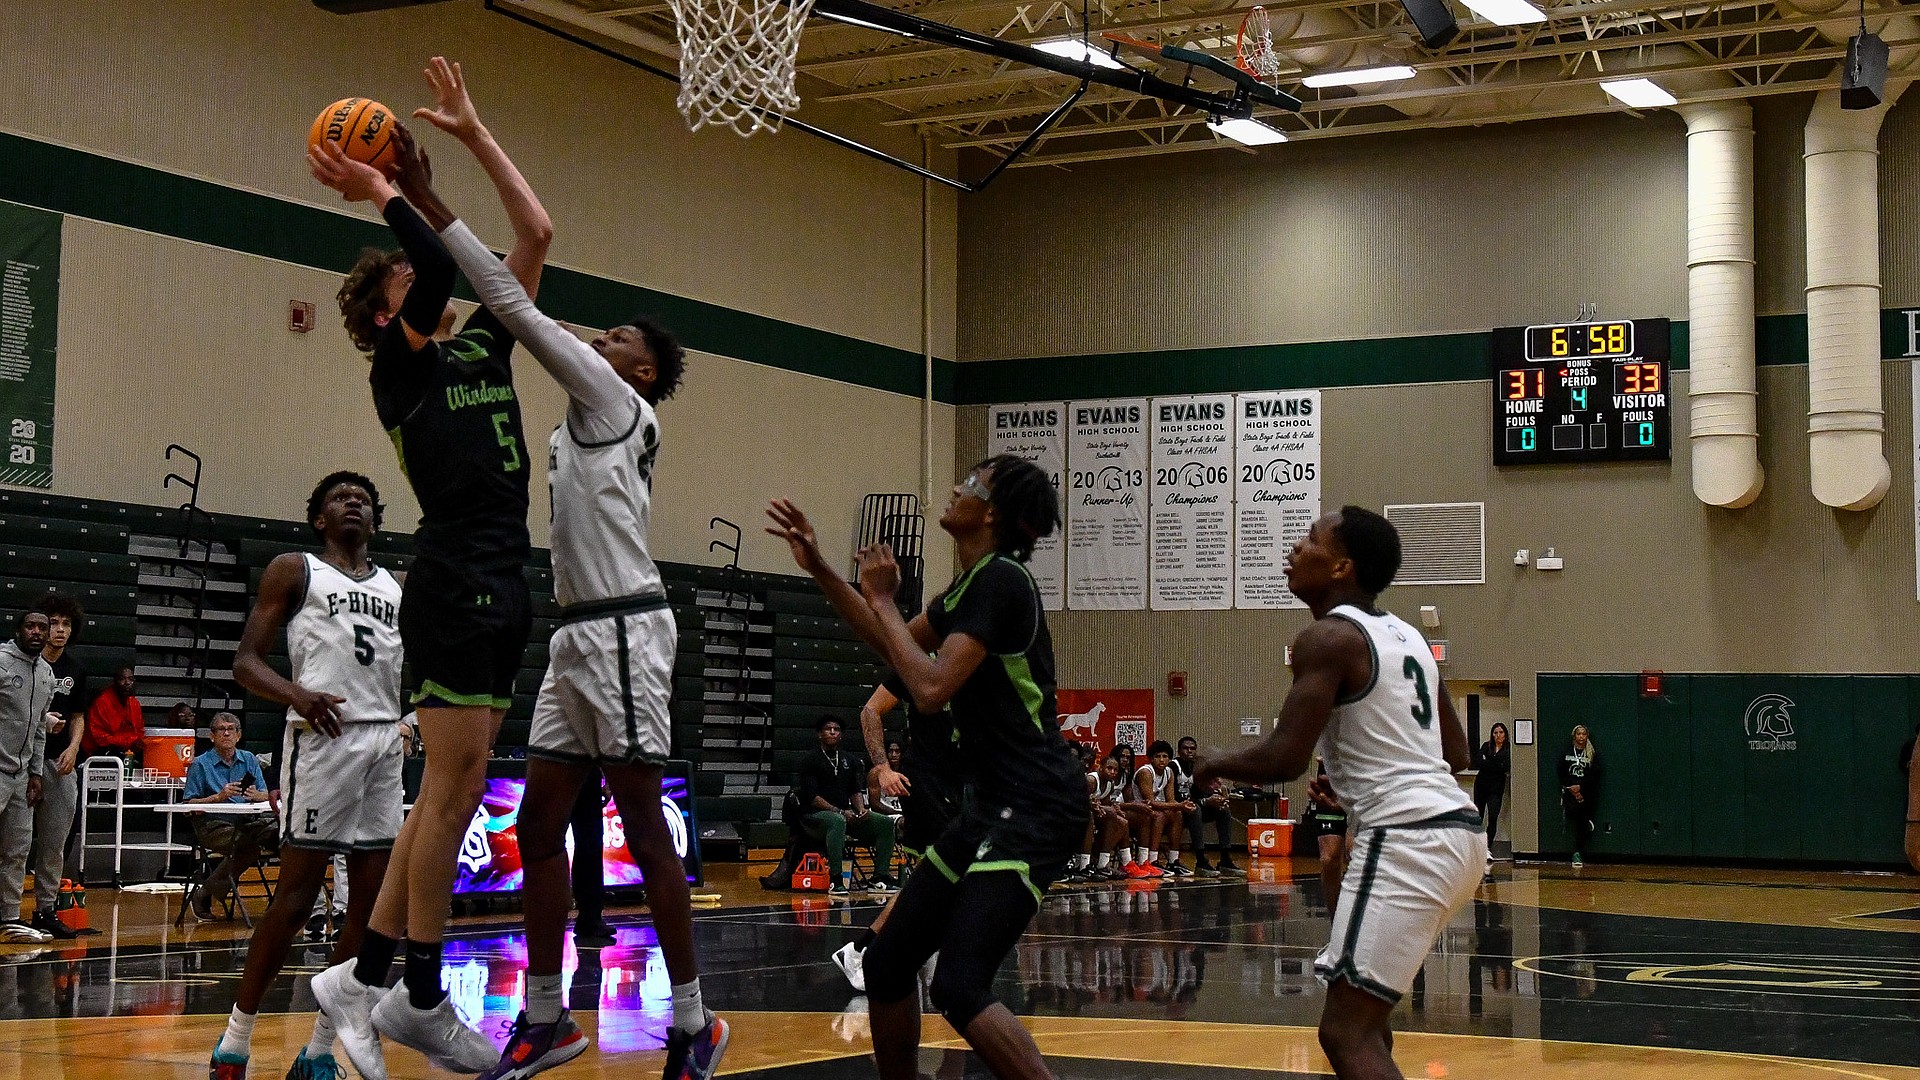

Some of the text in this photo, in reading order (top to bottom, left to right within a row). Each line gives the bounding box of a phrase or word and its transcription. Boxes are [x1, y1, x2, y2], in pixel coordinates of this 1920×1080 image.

[1552, 325, 1624, 355] 6:58
[1562, 376, 1597, 387] PERIOD
[1570, 368, 1588, 376] POSS
[1624, 364, 1659, 392] 33
[1509, 371, 1543, 398] 31
[1506, 400, 1543, 413] HOME
[1572, 388, 1585, 409] 4
[1613, 394, 1665, 408] VISITOR
[1076, 405, 1140, 425] EVANS
[1160, 403, 1225, 422] EVANS
[1245, 398, 1313, 419] EVANS
[1597, 413, 1602, 422] F
[1623, 411, 1653, 421] FOULS
[996, 409, 1058, 429] EVANS
[1246, 420, 1311, 429] HIGH SCHOOL
[1506, 416, 1535, 426] FOULS
[1562, 415, 1574, 424] NO
[492, 413, 520, 471] 5
[1174, 437, 1188, 446] Boys
[1243, 433, 1258, 441] State
[1259, 433, 1273, 443] Boys
[1522, 428, 1534, 450] 0
[1640, 423, 1652, 445] 0
[10, 445, 35, 464] 20
[1074, 470, 1142, 488] 20 13
[1157, 466, 1227, 485] 20 06
[1242, 463, 1315, 482] 20 05
[1082, 493, 1134, 508] Runner-Up
[1166, 493, 1218, 508] Champions
[1253, 490, 1307, 506] Champions
[327, 592, 394, 629] E-HIGH
[353, 624, 376, 666] 5
[1403, 655, 1432, 729] 3
[1749, 741, 1797, 752] TROJANS
[305, 809, 318, 833] E
[1260, 830, 1275, 848] G
